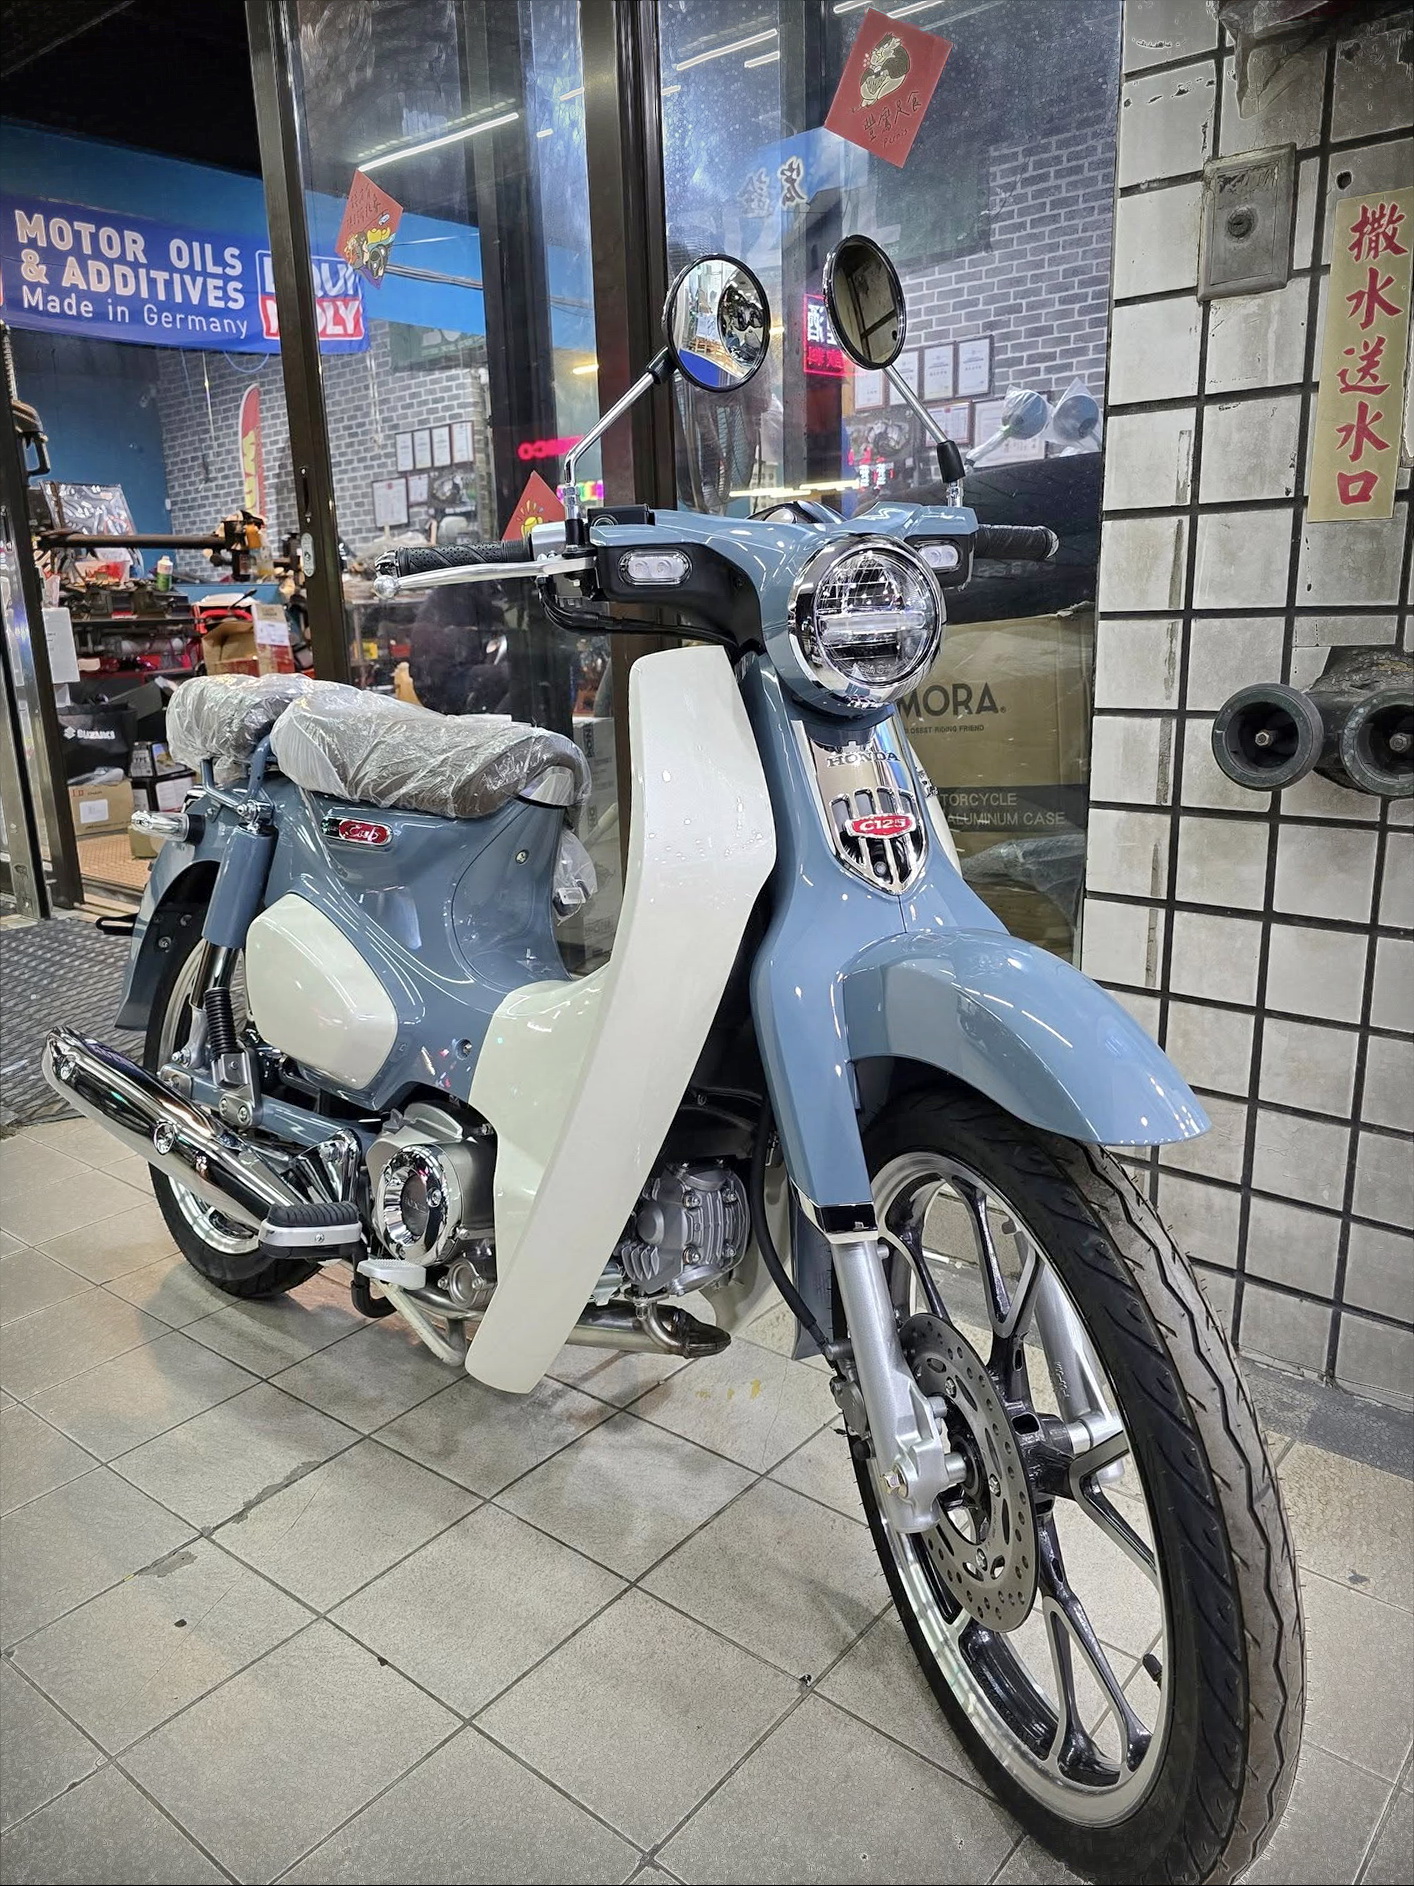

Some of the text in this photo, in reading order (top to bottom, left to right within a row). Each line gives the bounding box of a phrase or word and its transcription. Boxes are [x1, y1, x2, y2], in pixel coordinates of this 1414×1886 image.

[15, 209, 242, 276] MOTOR OILS
[21, 248, 245, 310] & ADDITIVES
[263, 256, 355, 297] LUI
[22, 284, 248, 340] Made in Germany
[265, 300, 360, 335] LY
[1336, 202, 1409, 506] 撒水送水口
[959, 723, 985, 732] FRIEND
[827, 751, 901, 768] HONDA
[859, 818, 906, 831] C125
[947, 811, 1066, 826] ALUMINUM CASE
